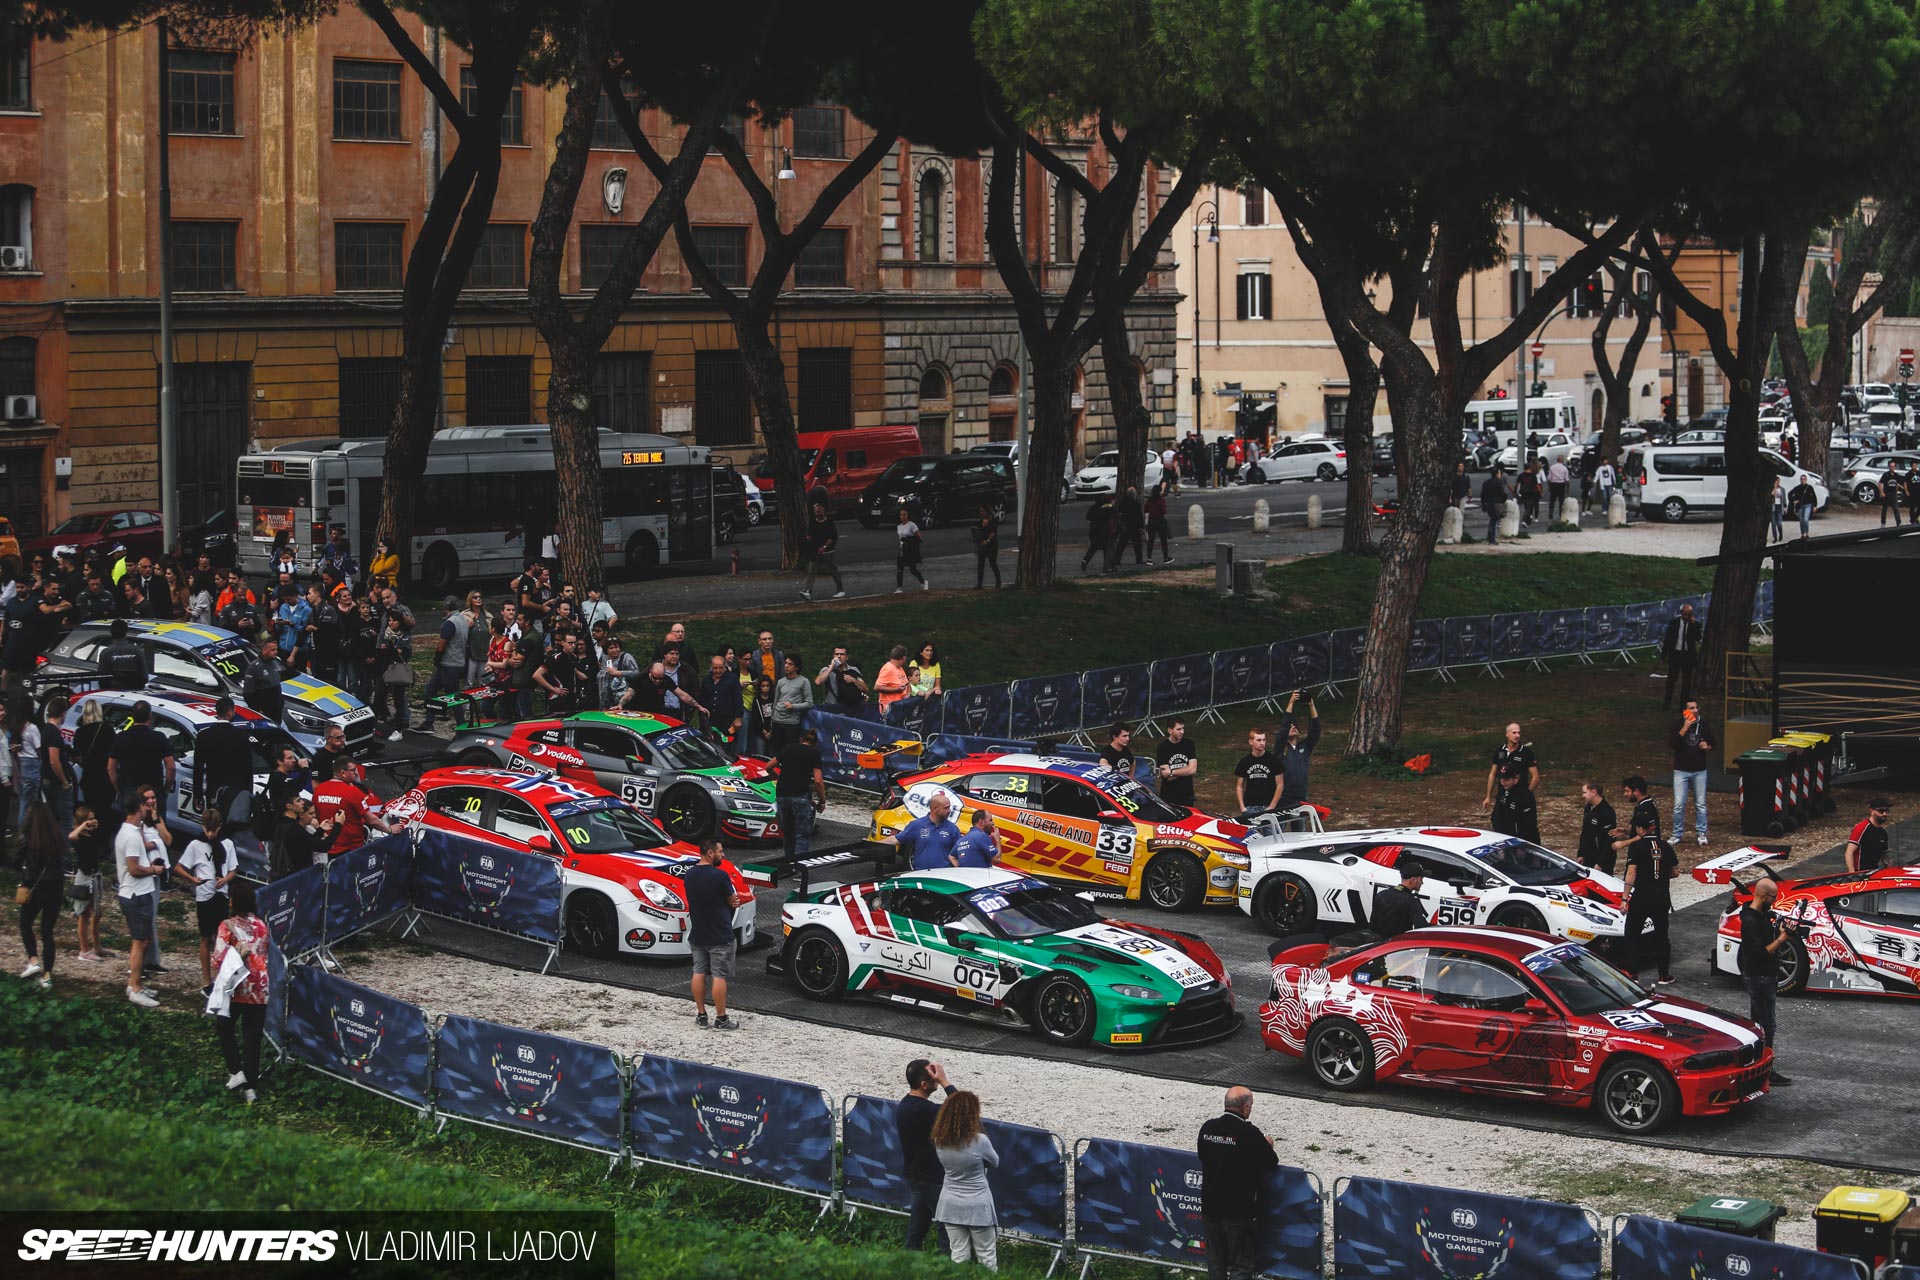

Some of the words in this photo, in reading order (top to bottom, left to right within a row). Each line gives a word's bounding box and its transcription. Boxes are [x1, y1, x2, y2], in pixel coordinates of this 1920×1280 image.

[623, 452, 632, 465] 715
[216, 660, 240, 676] 26
[343, 708, 371, 722] SWEDEN
[850, 729, 863, 741] FIA
[837, 741, 871, 752] MOTORSPOR
[547, 749, 584, 766] vodafone
[1005, 776, 1028, 793] 33
[318, 795, 342, 805] NORWAY
[623, 785, 653, 807] 99
[982, 790, 989, 798] T.
[992, 792, 1028, 805] Coronel
[464, 796, 482, 814] 10
[1116, 796, 1140, 813] 33
[1016, 811, 1092, 844] NEDERLAND
[566, 827, 591, 845] 10
[1098, 831, 1132, 854] 33
[1154, 839, 1204, 852] PRESTIGE
[481, 857, 494, 870] FIA
[1105, 863, 1129, 874] FEBO
[466, 871, 507, 885] MOTORSPORT
[475, 880, 497, 889] GAMES
[1545, 890, 1584, 905] 519
[1438, 906, 1476, 925] 519
[661, 933, 681, 942] TCR
[881, 946, 931, 971] الكويت
[954, 964, 999, 992] 007
[1170, 970, 1183, 981] Q8
[1178, 973, 1211, 987] KUWAIT
[352, 1000, 364, 1016] FIA
[337, 1016, 378, 1035] MOTORSPORT
[1608, 1014, 1651, 1028] 21
[346, 1026, 368, 1039] GAMES
[1580, 1039, 1599, 1048] Kraud
[518, 1046, 534, 1062] FIA
[500, 1064, 553, 1081] MOTORSPORT
[512, 1074, 541, 1086] GAMES
[720, 1087, 739, 1103] FIA
[701, 1105, 758, 1122] MOTORSPORT
[715, 1116, 745, 1127] GAMES
[1452, 1211, 1475, 1227] FIA
[1428, 1231, 1501, 1248] MOTORSPORT
[1446, 1243, 1485, 1254] GAMES
[1726, 1256, 1749, 1274] FIA
